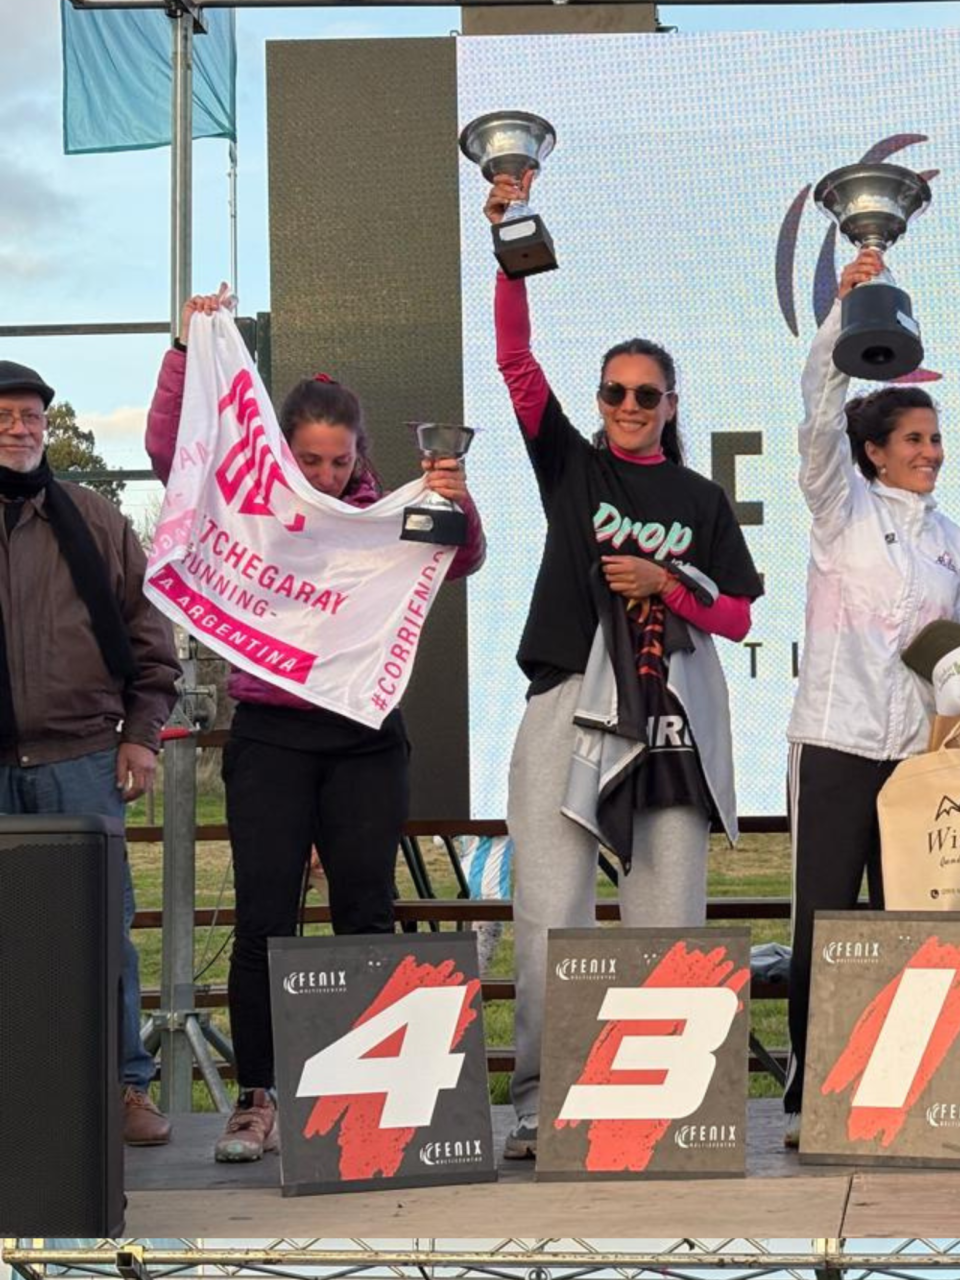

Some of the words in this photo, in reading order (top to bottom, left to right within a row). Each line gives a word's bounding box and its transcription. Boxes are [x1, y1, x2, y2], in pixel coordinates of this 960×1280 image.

[593, 502, 692, 561] Drop
[200, 515, 348, 614] TCHEGARAY
[177, 596, 297, 672] ARGENTINA
[570, 958, 616, 974] FENIX
[836, 942, 879, 957] FENIX
[299, 971, 346, 987] FENIX
[296, 986, 467, 1128] 4
[559, 988, 738, 1119] 3
[434, 1140, 481, 1158] FENIX
[690, 1125, 736, 1141] FENIX
